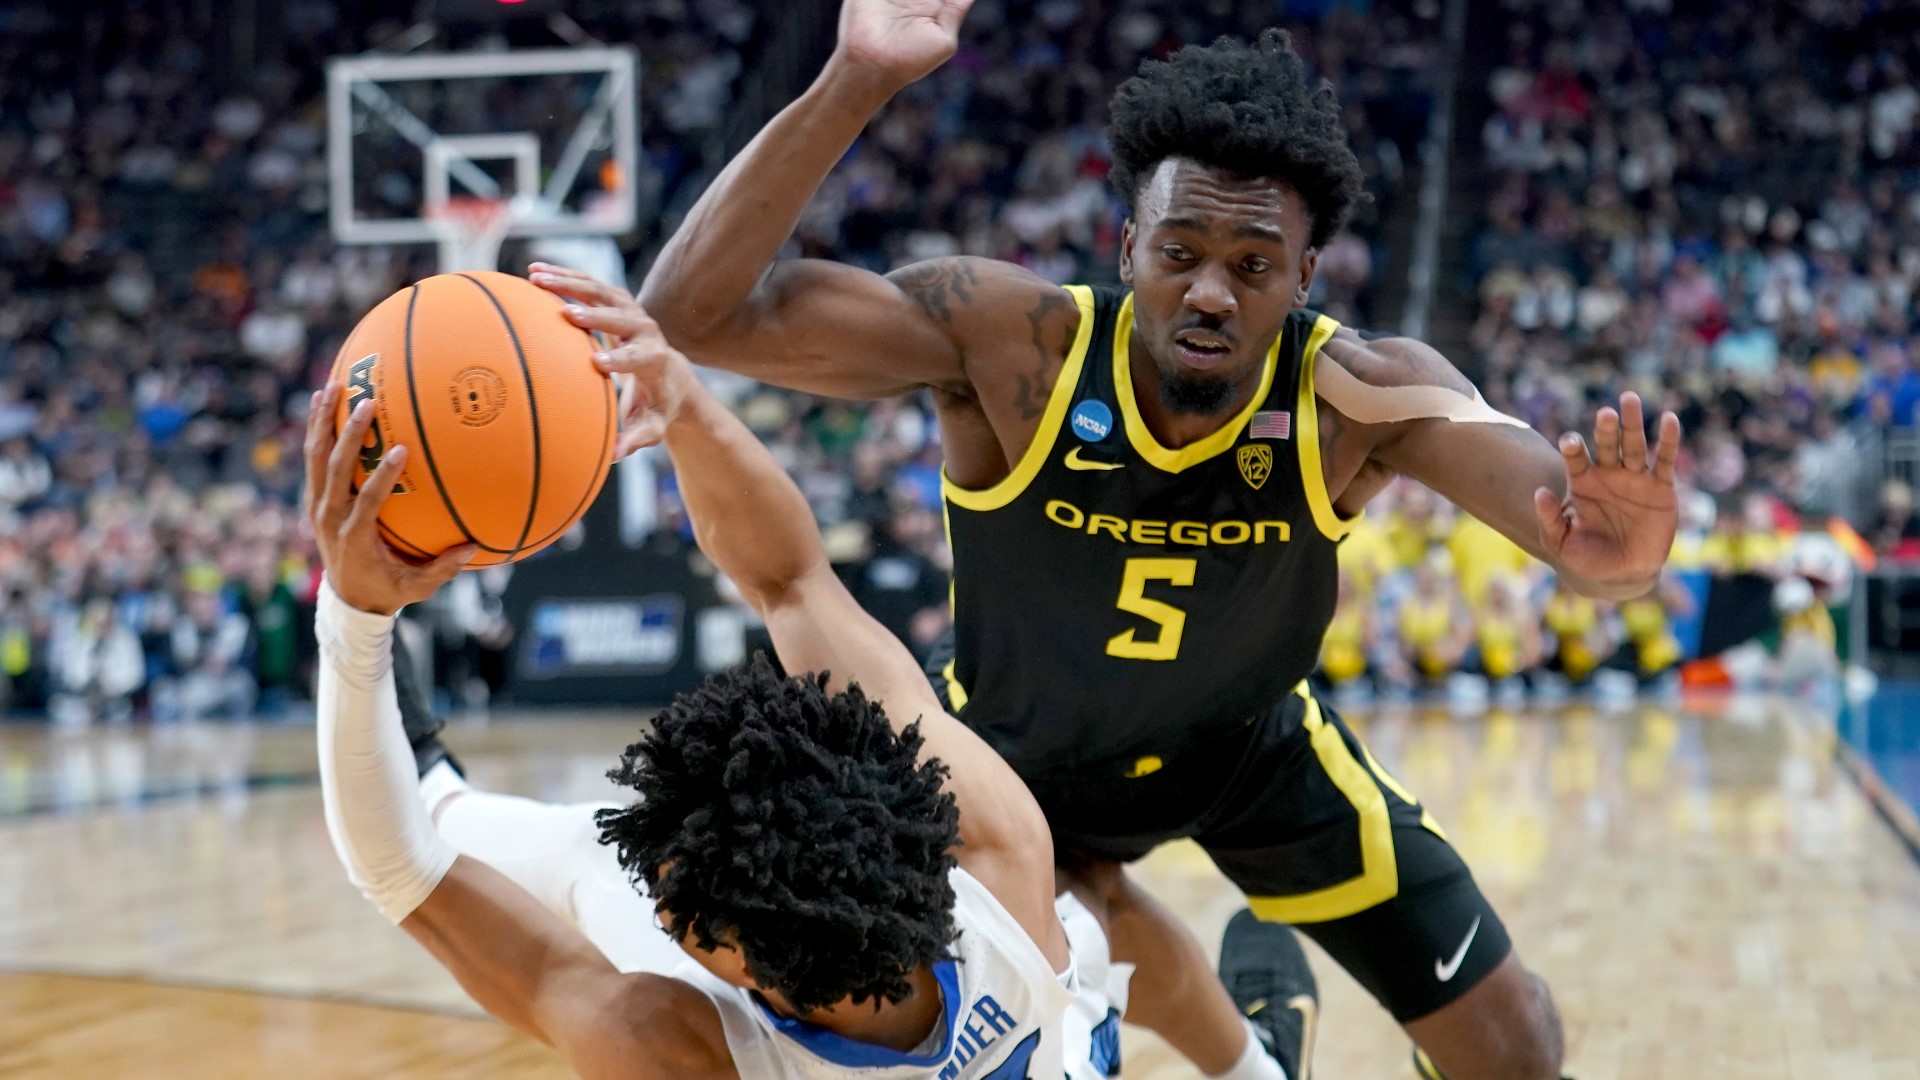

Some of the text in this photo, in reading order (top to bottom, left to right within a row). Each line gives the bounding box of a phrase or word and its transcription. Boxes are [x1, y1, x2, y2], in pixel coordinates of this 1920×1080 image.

[1075, 413, 1107, 437] NCAA
[1240, 447, 1271, 472] PAC
[1248, 462, 1264, 480] 12
[1045, 500, 1291, 546] OREGON
[1105, 558, 1198, 660] 5
